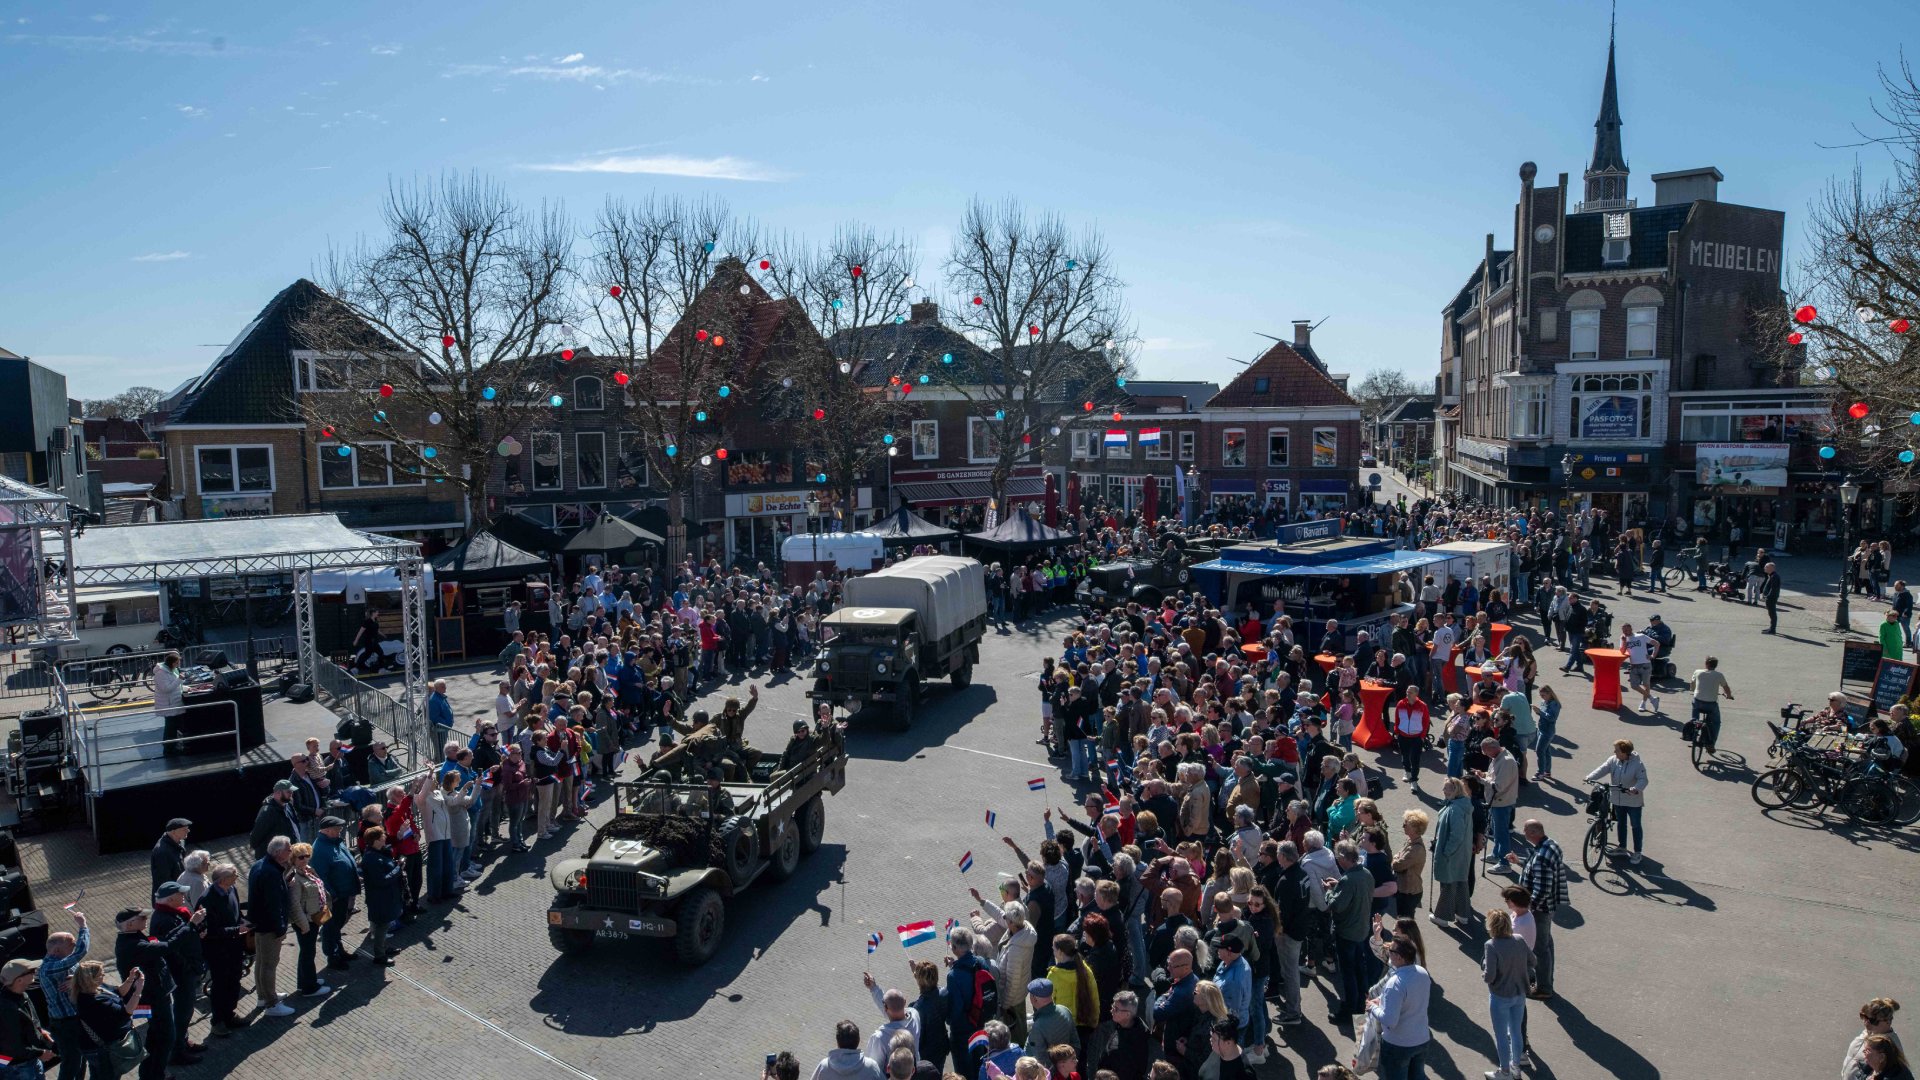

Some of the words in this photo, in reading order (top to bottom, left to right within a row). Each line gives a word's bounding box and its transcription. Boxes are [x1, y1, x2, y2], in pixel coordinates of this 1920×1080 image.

[1689, 240, 1779, 274] MEUBELEN
[1586, 399, 1601, 412] HIER
[1273, 483, 1291, 491] SNS
[225, 508, 270, 517] Venhorst
[766, 504, 778, 512] De
[779, 502, 802, 510] Echte
[1303, 524, 1329, 538] Bavaria
